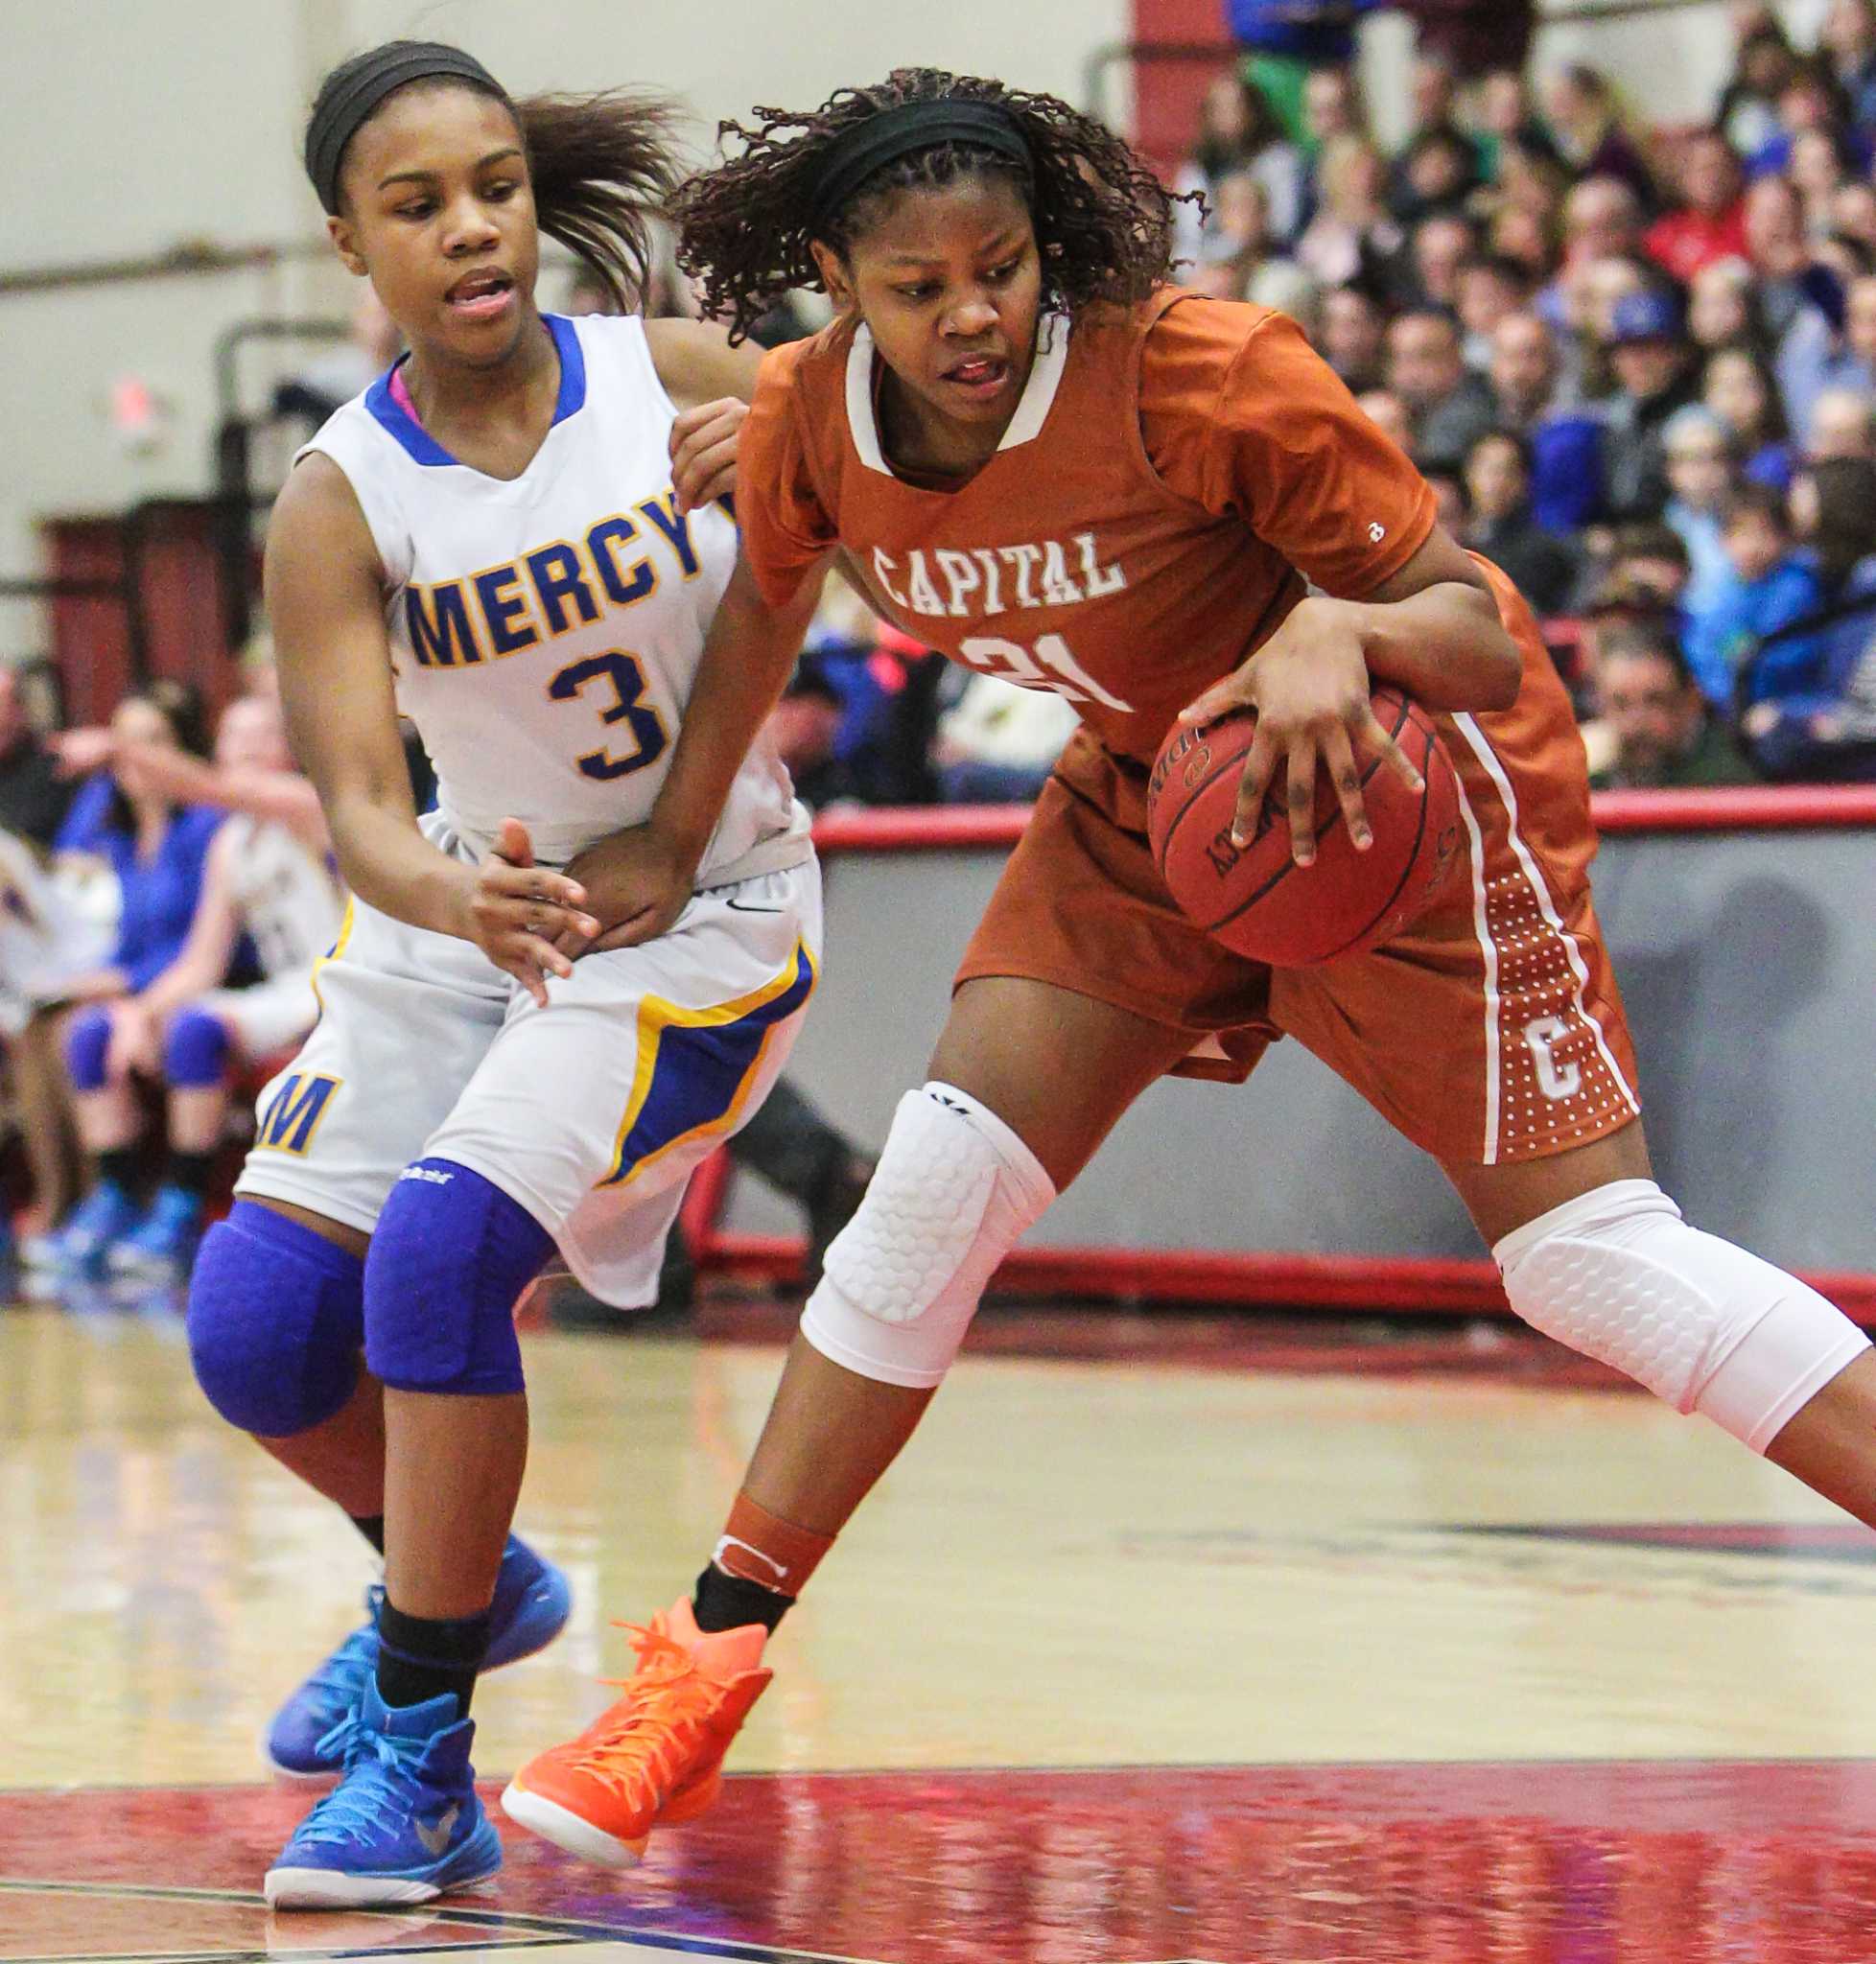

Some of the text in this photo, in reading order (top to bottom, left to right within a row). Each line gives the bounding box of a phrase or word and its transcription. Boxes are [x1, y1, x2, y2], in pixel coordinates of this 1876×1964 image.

[404, 485, 703, 668] MERCY
[872, 531, 1128, 617] CAPITAL
[548, 647, 671, 782] 3
[1522, 1016, 1582, 1100] C
[254, 1069, 345, 1158] M
